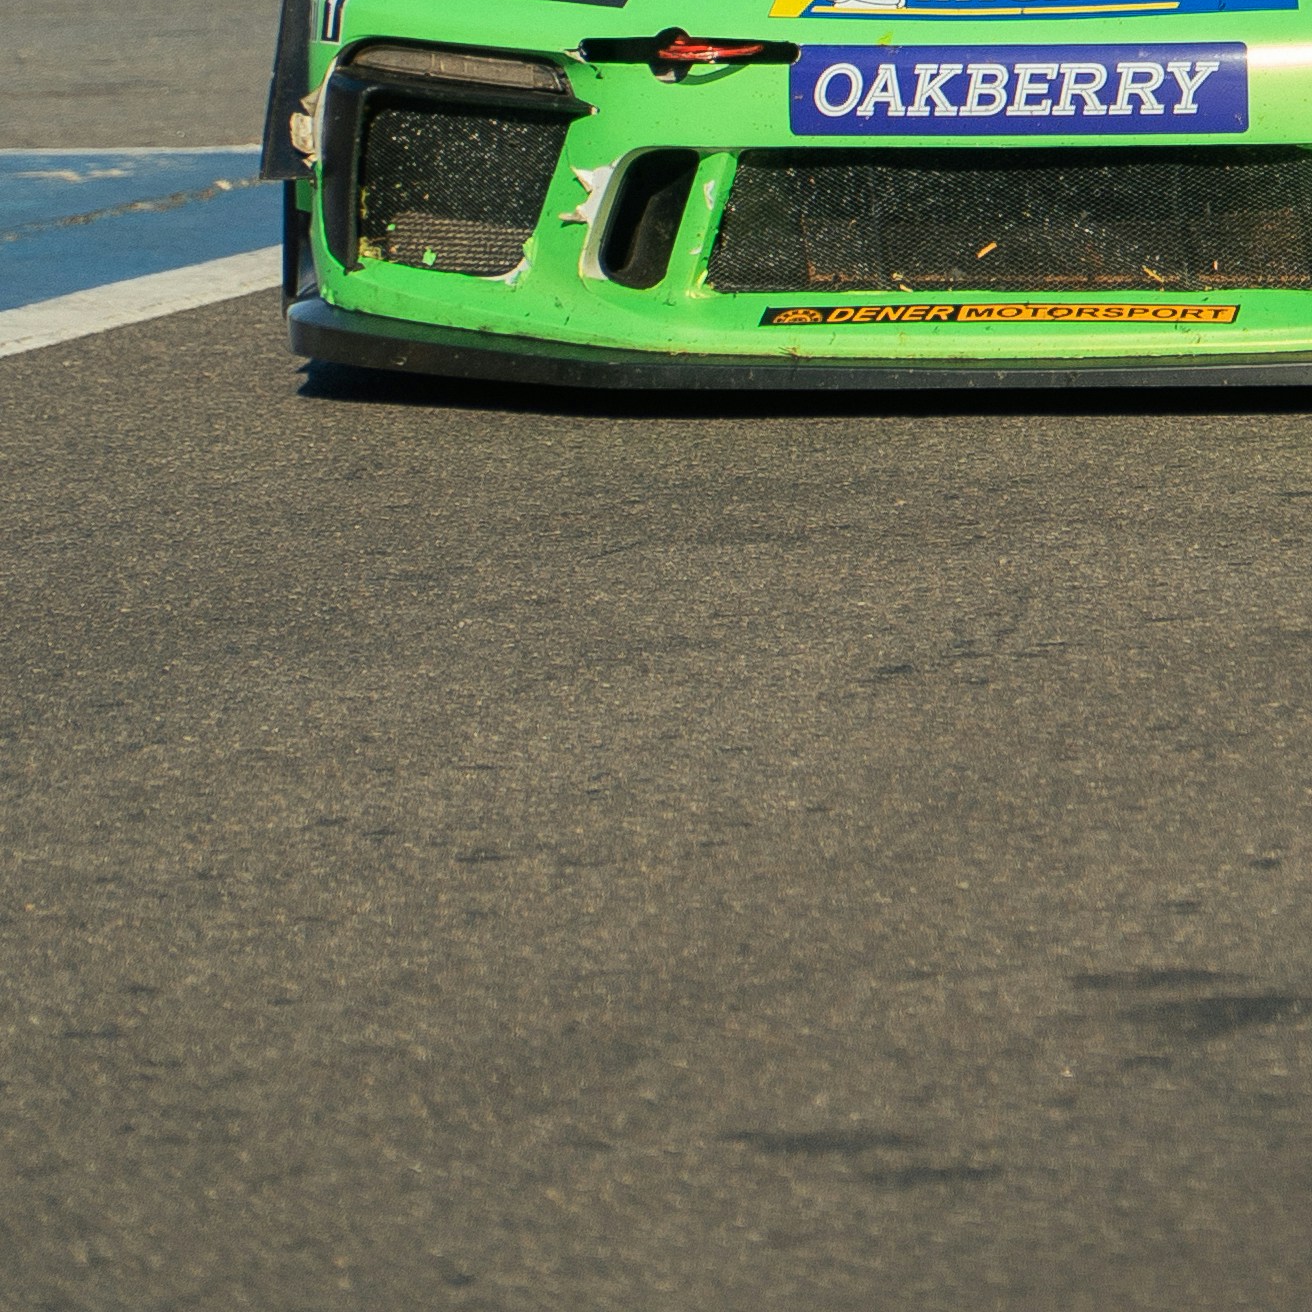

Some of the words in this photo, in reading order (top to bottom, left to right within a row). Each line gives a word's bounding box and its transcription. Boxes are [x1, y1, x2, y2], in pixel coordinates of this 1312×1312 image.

[813, 60, 1219, 117] OAKBERRY
[826, 305, 954, 322] DENER
[965, 307, 1230, 320] MOTORSPORT
